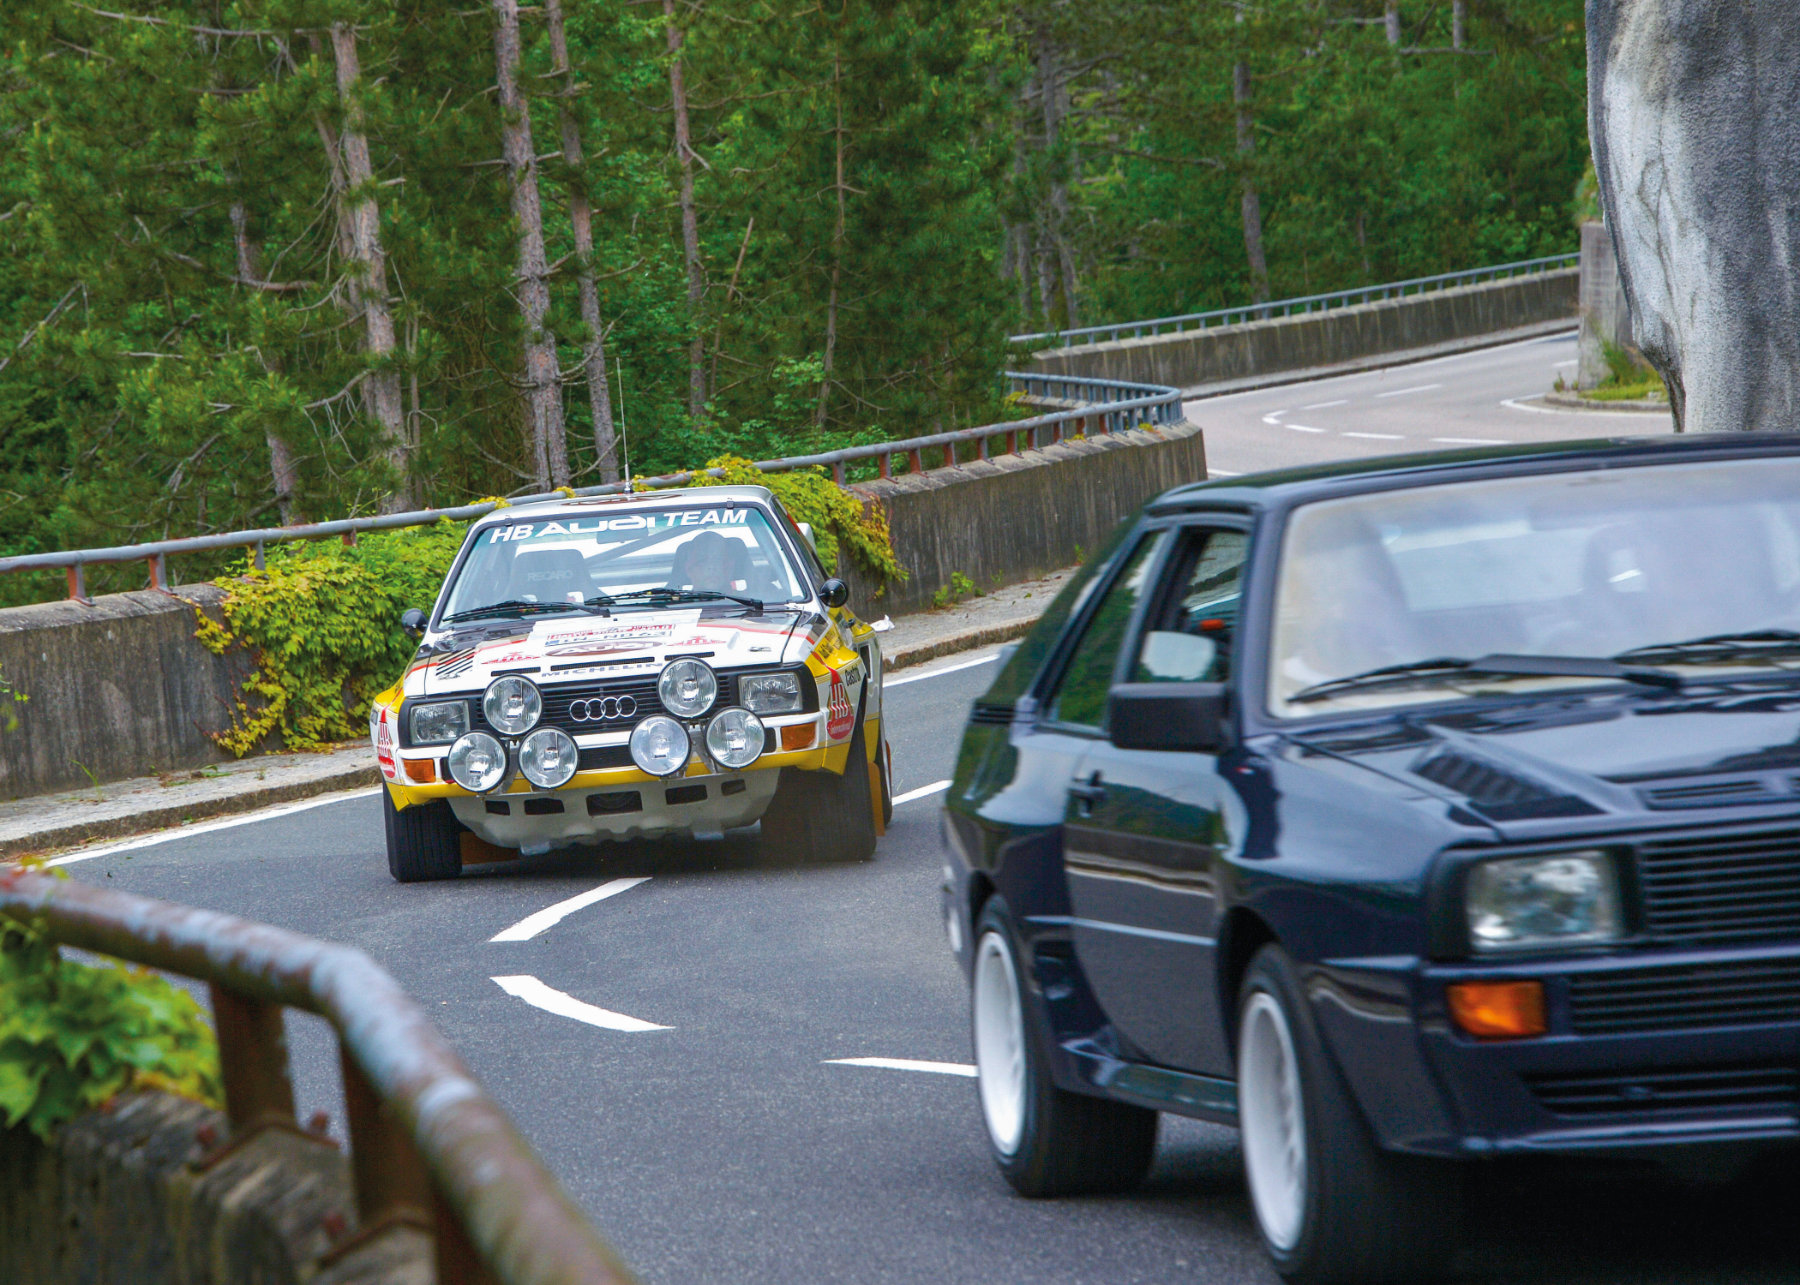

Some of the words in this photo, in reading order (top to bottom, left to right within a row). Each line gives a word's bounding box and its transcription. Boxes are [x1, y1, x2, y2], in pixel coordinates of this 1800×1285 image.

[489, 525, 533, 544] HB
[538, 515, 656, 536] AUDI
[663, 509, 748, 527] TEAM
[527, 570, 574, 581] RECARO
[551, 641, 655, 656] AUDI
[541, 662, 663, 678] MICHELIN
